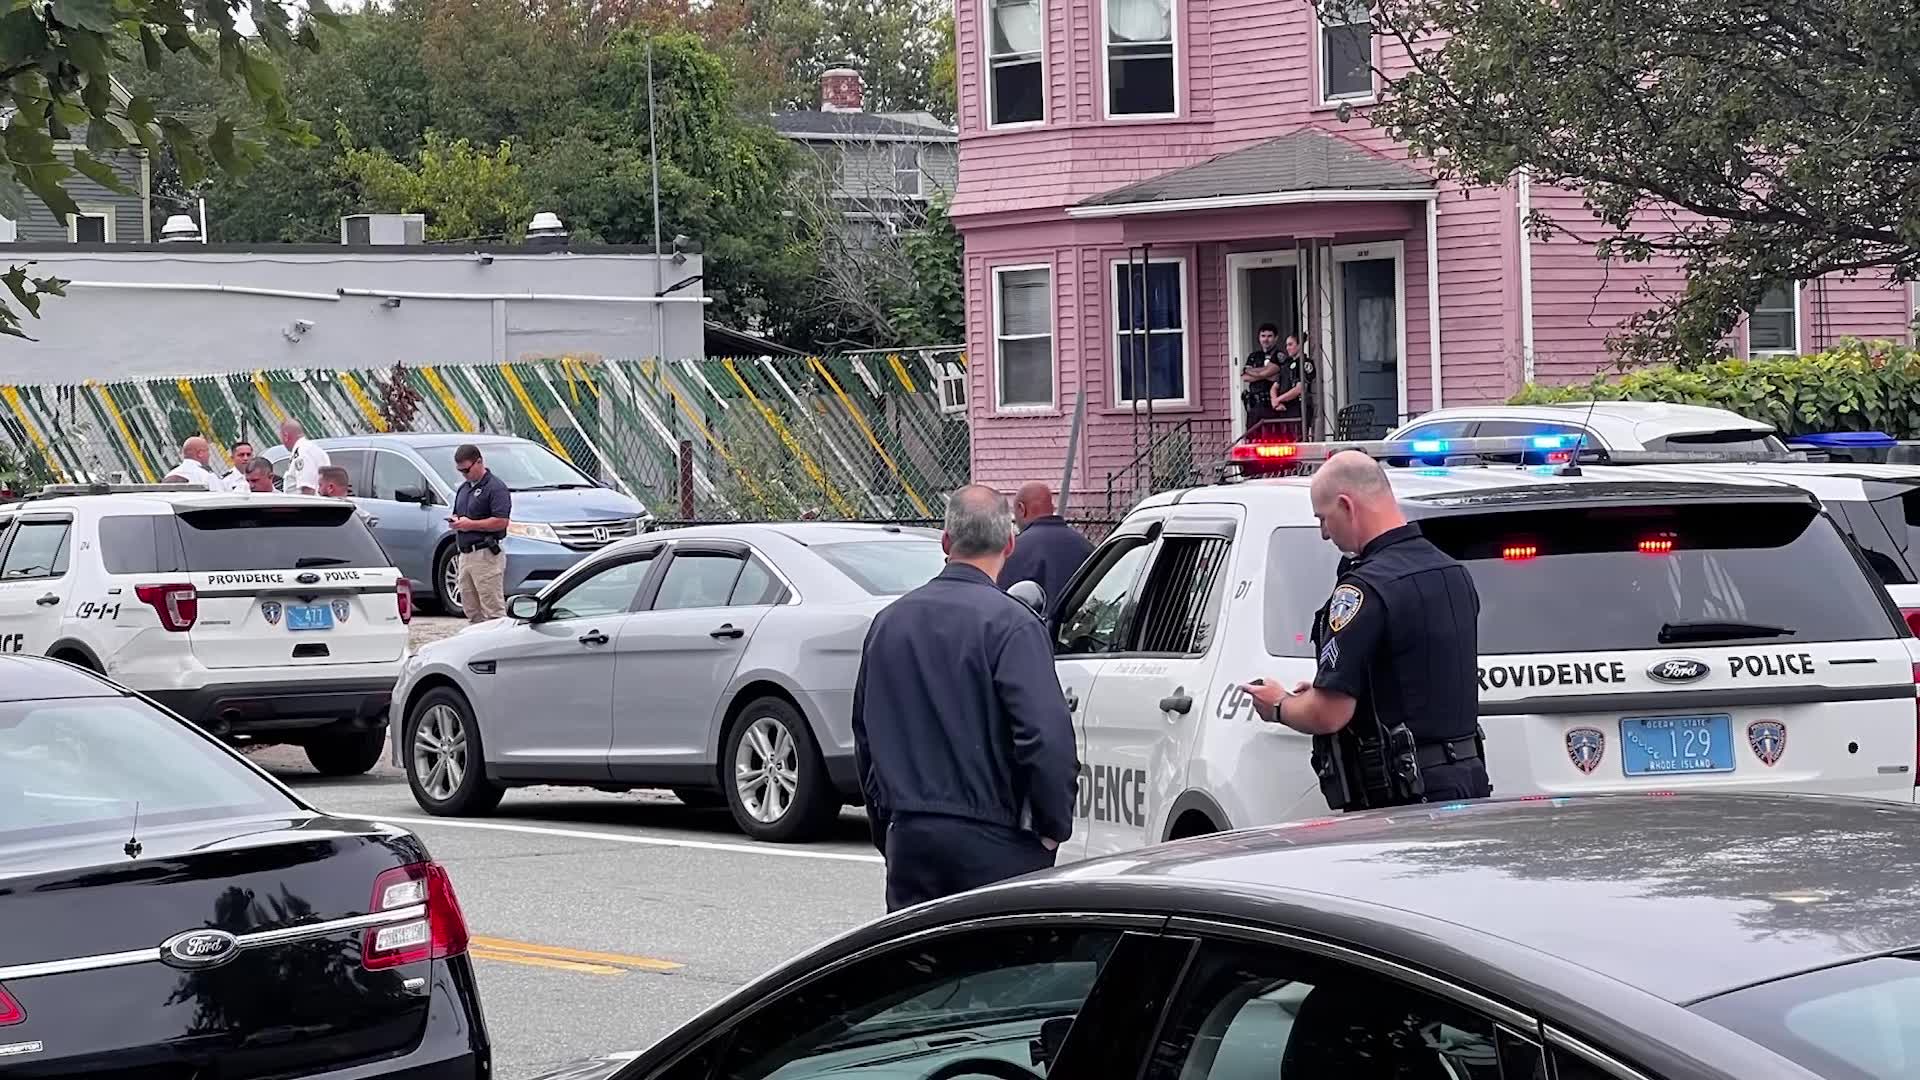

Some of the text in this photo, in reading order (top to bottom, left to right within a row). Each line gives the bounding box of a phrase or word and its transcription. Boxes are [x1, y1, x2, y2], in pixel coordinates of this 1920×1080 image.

[208, 574, 284, 585] PROVIDENCE
[324, 571, 360, 581] POLICE
[1728, 653, 1815, 678] POLICE
[1646, 719, 1705, 729] OCEAN STATE
[1670, 729, 1711, 758] 129
[1649, 759, 1711, 770] RHODE ISLAND
[1073, 764, 1146, 828] DENCE
[186, 935, 222, 956] Ford
